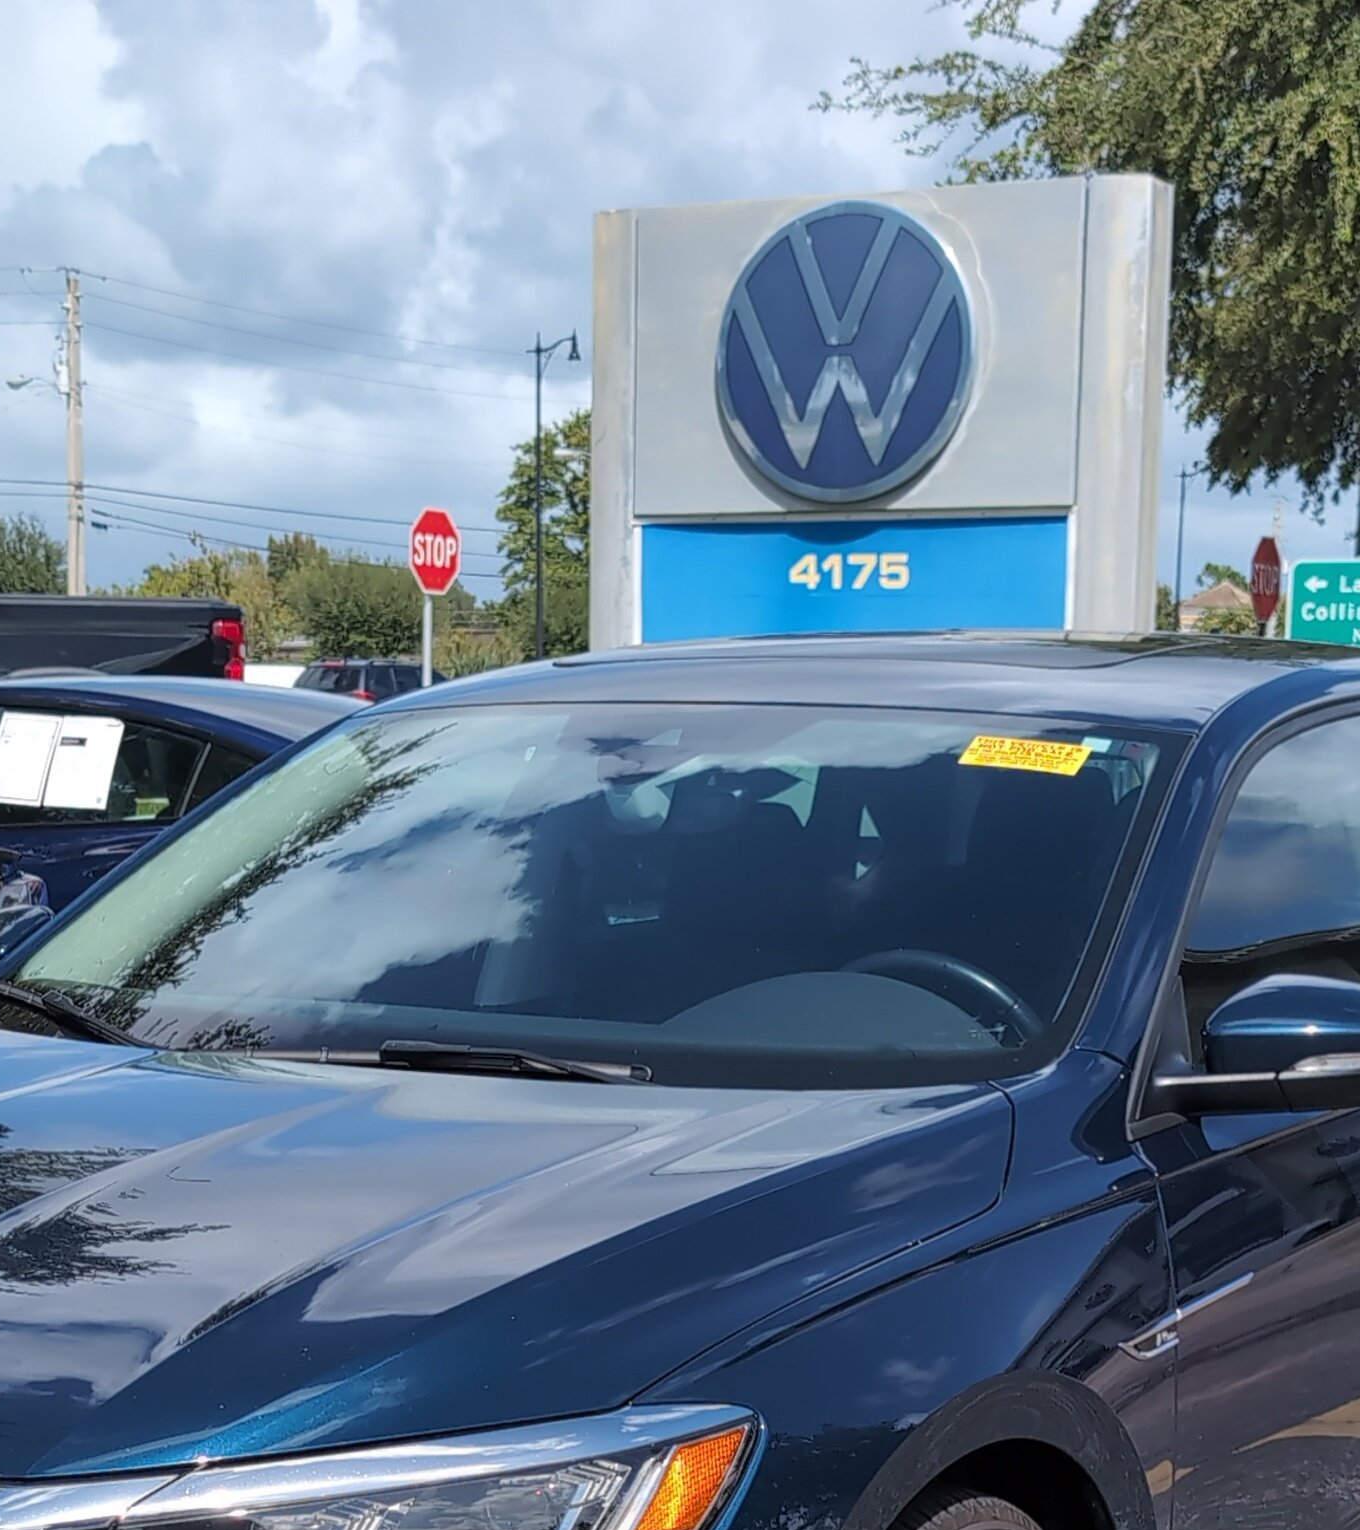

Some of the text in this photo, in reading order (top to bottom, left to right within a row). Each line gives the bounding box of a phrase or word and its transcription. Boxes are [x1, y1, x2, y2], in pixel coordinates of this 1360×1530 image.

[413, 532, 457, 569] STOP
[788, 552, 910, 590] 4175
[1249, 562, 1280, 596] STOP
